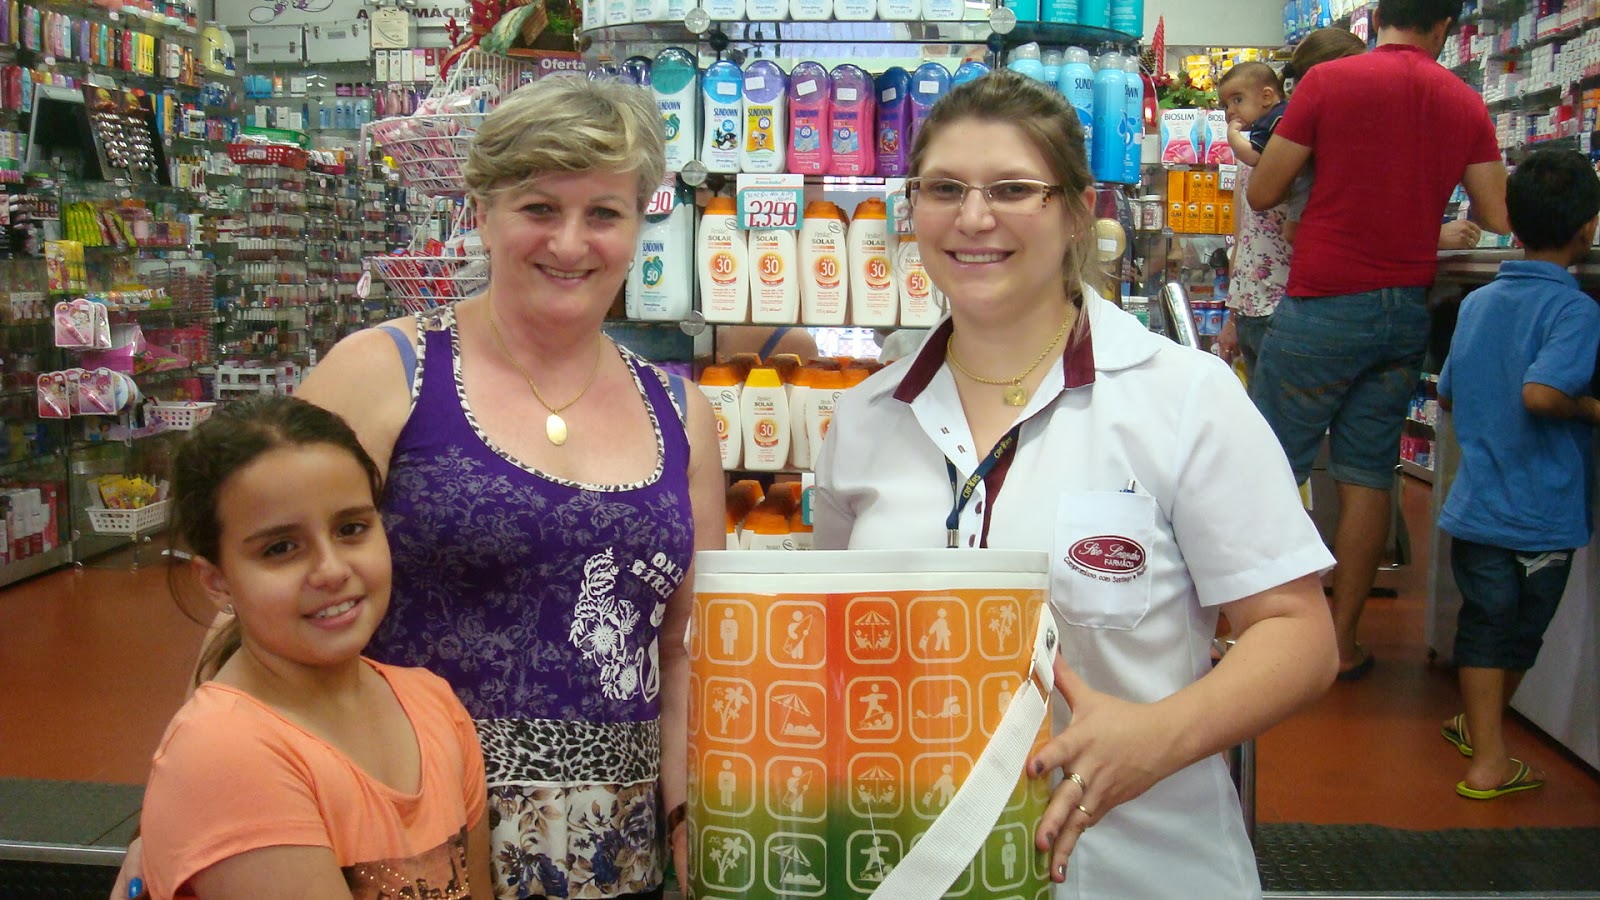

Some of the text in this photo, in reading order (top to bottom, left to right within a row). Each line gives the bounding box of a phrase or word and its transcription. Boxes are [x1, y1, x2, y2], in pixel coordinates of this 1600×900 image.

[541, 58, 587, 70] Oferta
[713, 107, 738, 117] SUNDOWN
[748, 107, 773, 117] SUNDOWN
[1164, 113, 1195, 121] BIOSLIM
[1208, 114, 1224, 122] BIOSL
[801, 128, 811, 136] 60
[840, 129, 850, 138] 60
[716, 259, 732, 273] 30
[764, 259, 779, 273] 30
[820, 262, 836, 276] 30
[870, 263, 886, 278] 30
[647, 271, 659, 281] 50
[911, 277, 925, 290] 50
[760, 424, 774, 437] 30
